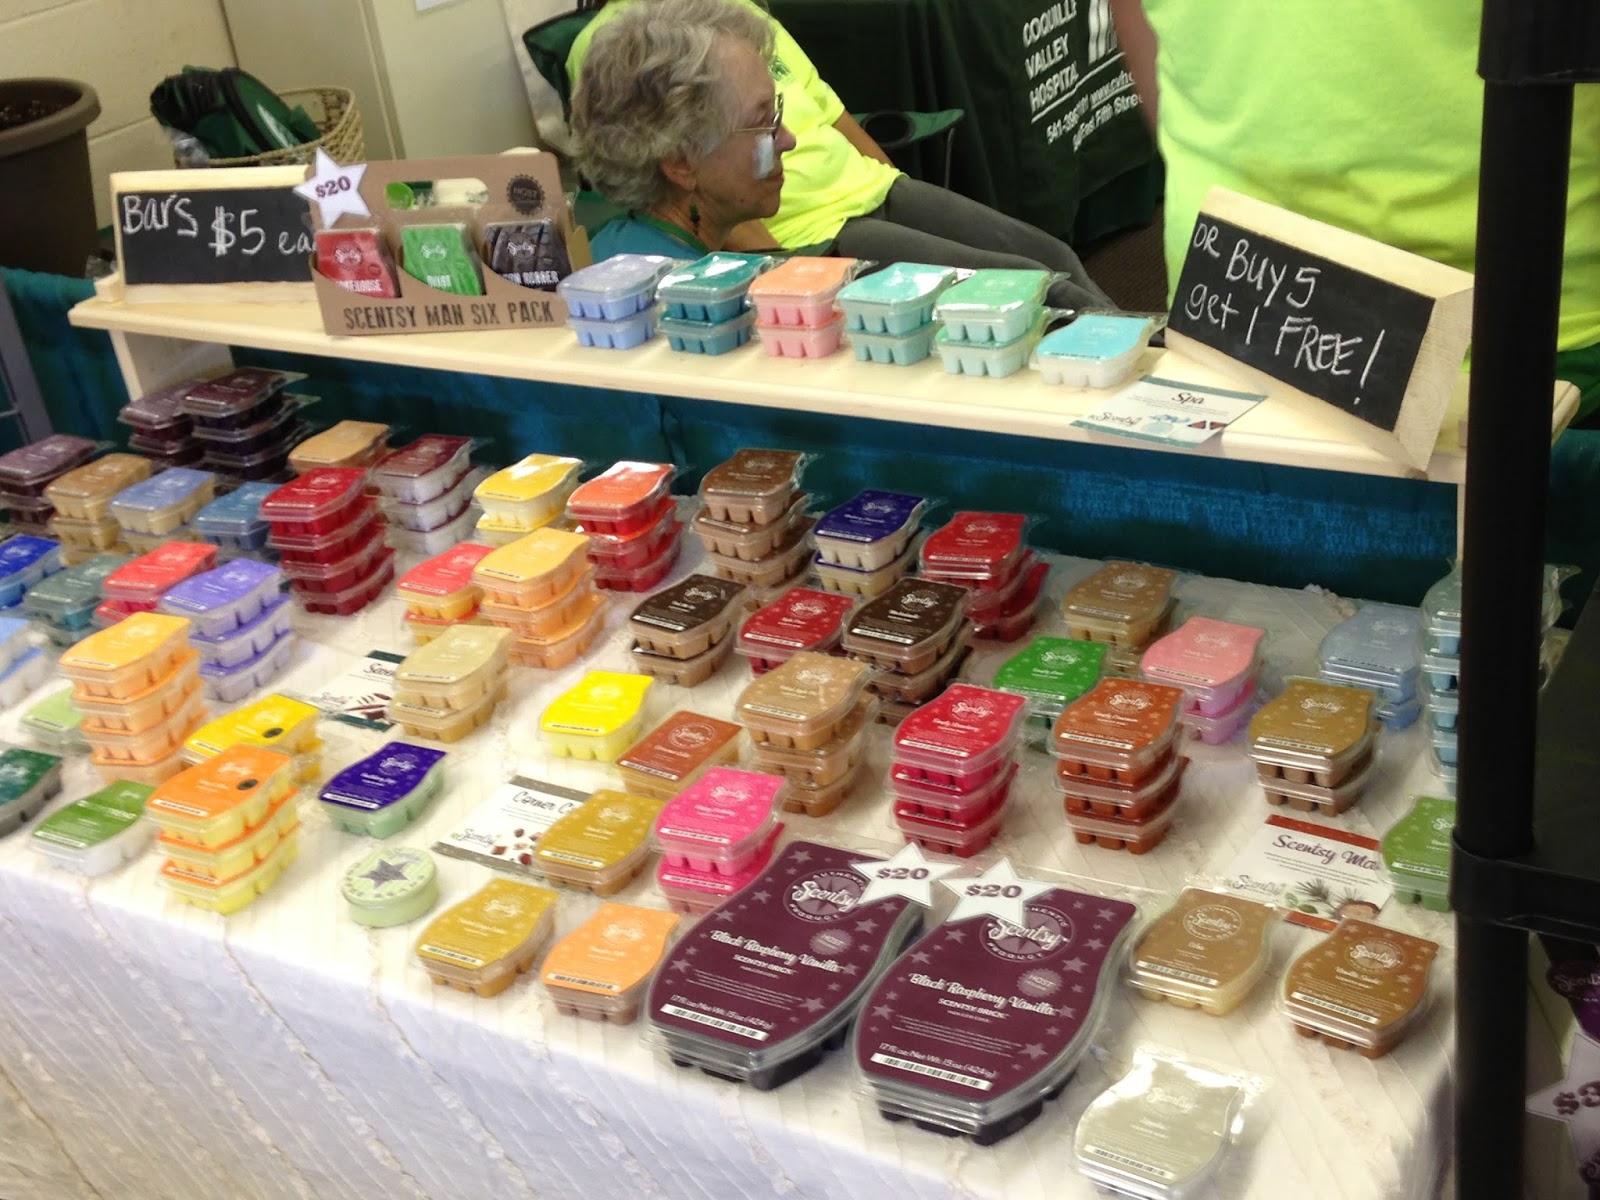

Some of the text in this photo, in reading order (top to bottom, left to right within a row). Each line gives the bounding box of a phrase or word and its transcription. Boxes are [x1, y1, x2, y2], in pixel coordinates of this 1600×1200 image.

[1025, 32, 1069, 80] VALLEY
[315, 175, 352, 199] $20
[122, 193, 199, 238] Bars
[208, 205, 266, 257] $5
[1193, 222, 1220, 259] OR
[1286, 266, 1322, 309] 5
[344, 300, 555, 330] SCENTSY MAN SIX PACK
[1184, 283, 1240, 331] get
[1171, 391, 1205, 405] Spa
[558, 802, 576, 815] C
[1272, 834, 1336, 865] Scentsy
[876, 866, 931, 881] $20
[791, 880, 860, 914] Scentsy
[965, 884, 1024, 900] $20
[987, 919, 1065, 951] Scentsy
[710, 930, 745, 948] Black
[743, 939, 799, 967] Raspberry
[798, 953, 846, 974] Vanilla
[732, 953, 768, 968] SCENTSY
[908, 972, 948, 991] Black
[946, 981, 1008, 1010] Raspberry
[1008, 996, 1060, 1017] Vanilla
[1027, 973, 1057, 988] HOST
[937, 998, 978, 1014] SCENTSY
